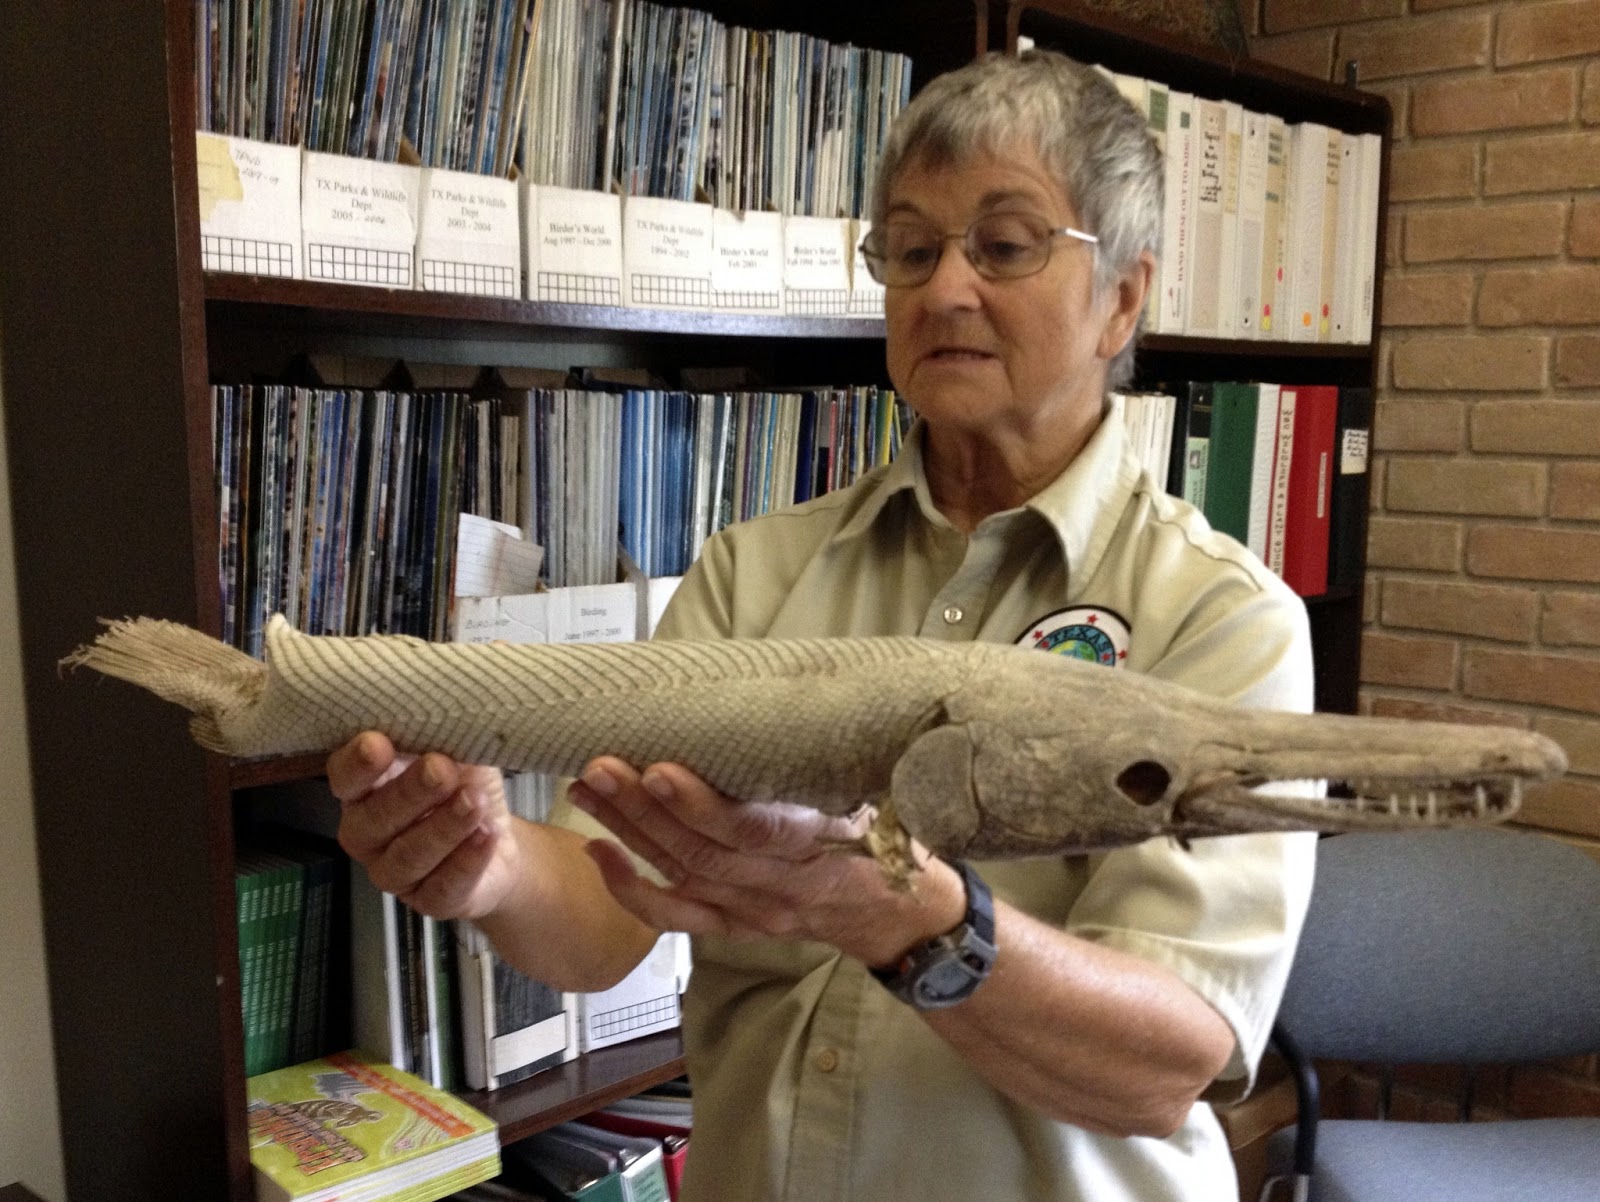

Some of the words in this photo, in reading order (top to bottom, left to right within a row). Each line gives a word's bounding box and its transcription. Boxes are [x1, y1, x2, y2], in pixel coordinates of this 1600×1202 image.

[1182, 170, 1189, 185] TO
[317, 178, 331, 191] TX
[334, 181, 358, 195] Parks
[360, 186, 369, 197] &
[372, 187, 407, 203] Wildlife
[351, 197, 373, 212] Dept
[431, 188, 443, 200] TX
[446, 190, 467, 203] Parks
[469, 194, 476, 204] &
[477, 194, 508, 209] Wildlife
[1180, 186, 1188, 212] OUT
[331, 208, 354, 222] 2005
[461, 206, 480, 219] Dept
[474, 220, 492, 232] 2004
[549, 222, 582, 234] Birder's
[583, 223, 606, 234] World
[637, 219, 648, 230] TX
[650, 220, 669, 233] Parks
[670, 224, 677, 234] &
[679, 224, 705, 237] Wildlife
[1178, 214, 1187, 248] THESE
[544, 236, 559, 247] Aug
[720, 246, 749, 257] Birder's
[749, 247, 770, 257] World
[794, 246, 818, 255] Birder's
[819, 246, 837, 256] World
[1177, 249, 1185, 283] HAND
[1049, 626, 1111, 653] TEXAS
